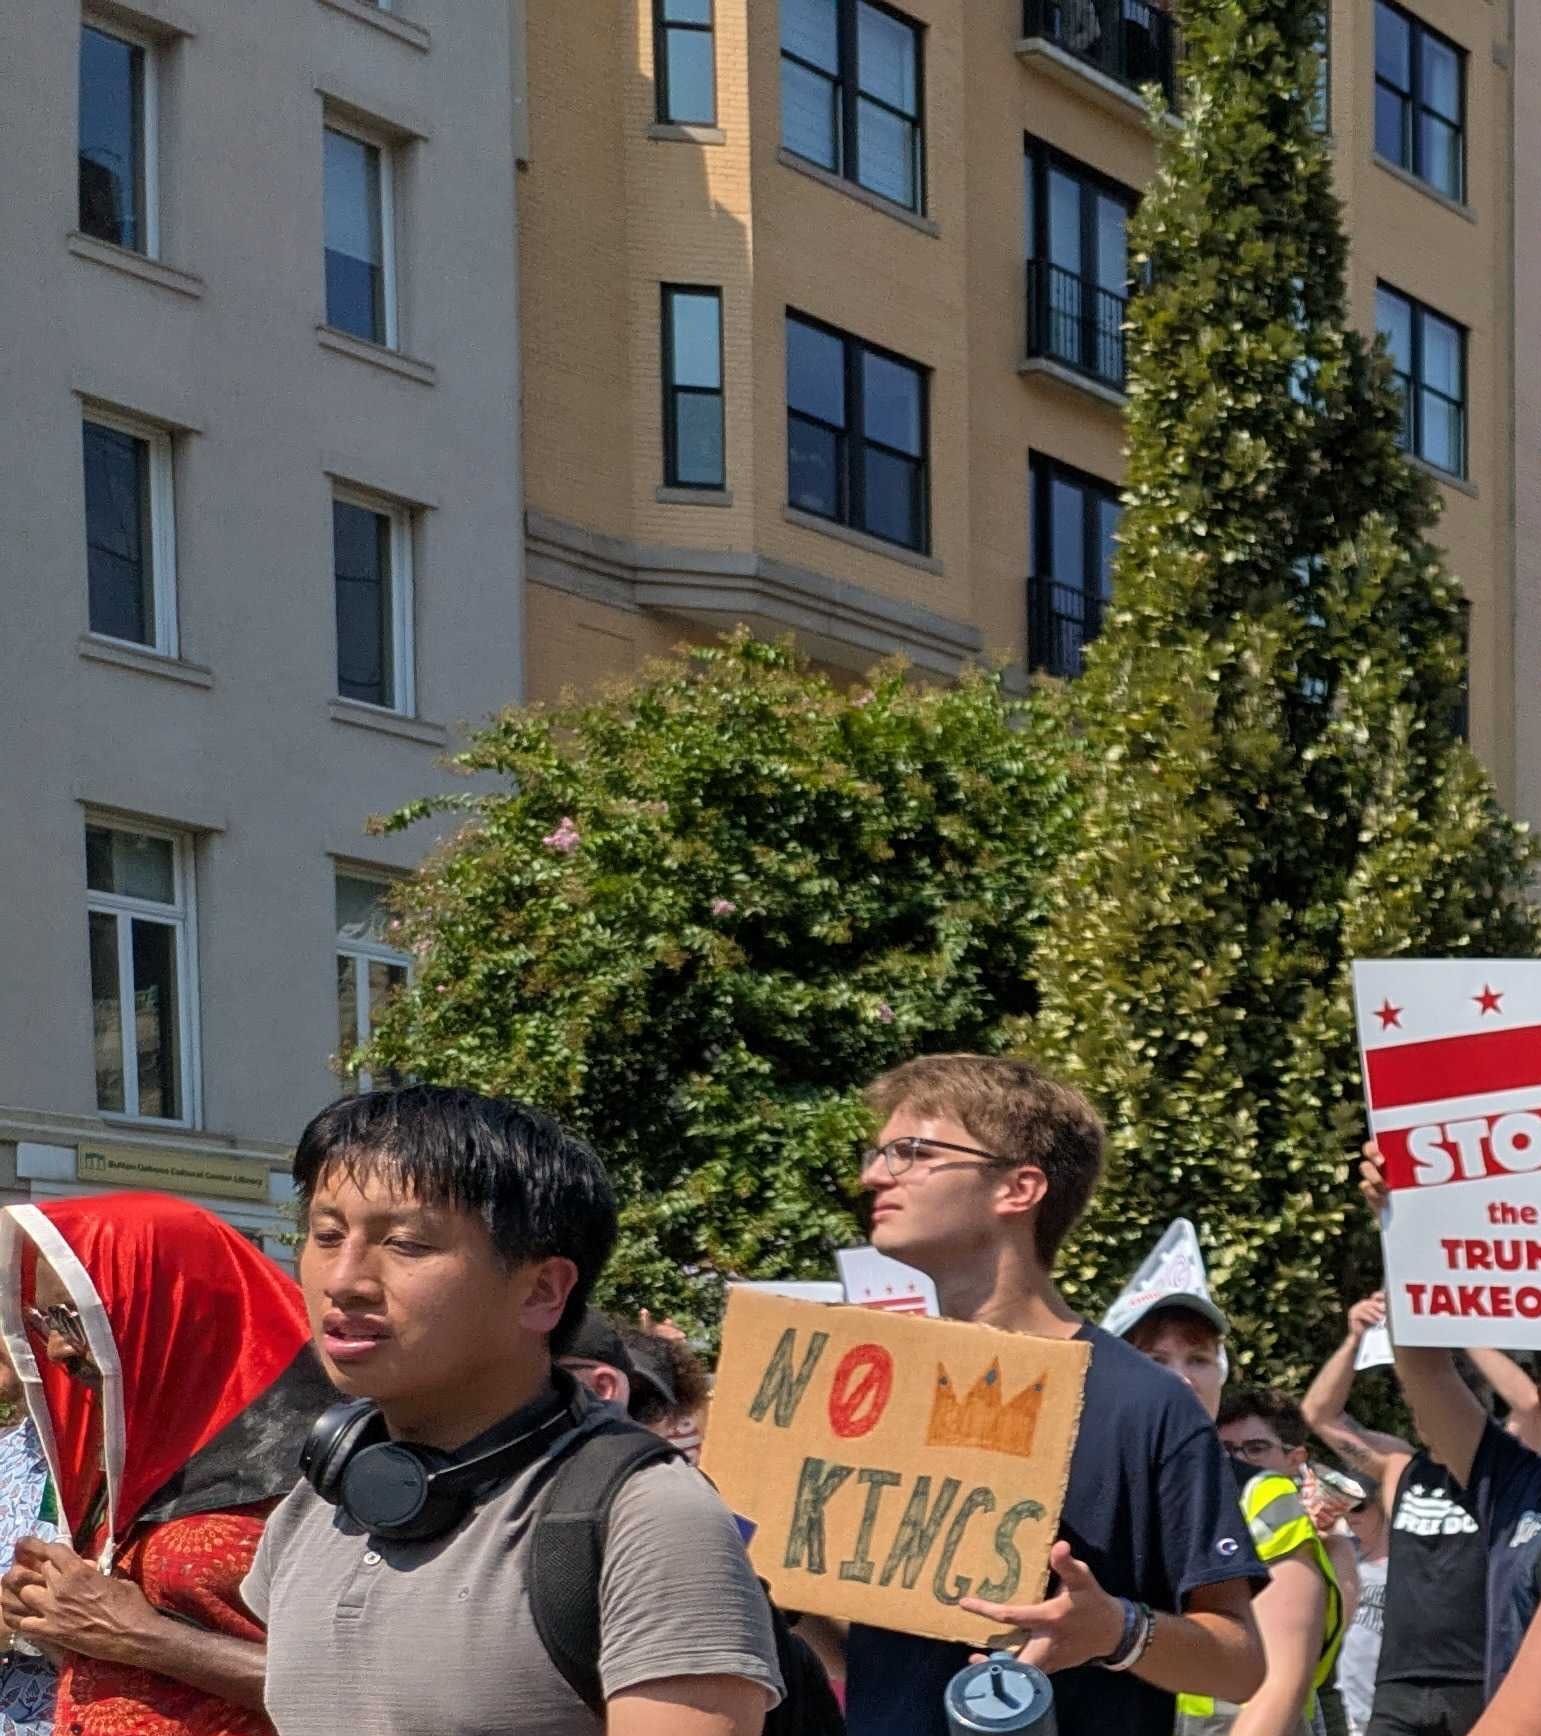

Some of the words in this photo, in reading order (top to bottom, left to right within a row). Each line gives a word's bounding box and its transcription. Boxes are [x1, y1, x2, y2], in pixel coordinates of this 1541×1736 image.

[1488, 1202, 1538, 1224] the
[749, 1328, 894, 1439] NO
[784, 1457, 1046, 1605] KINGS
[1393, 1511, 1441, 1536] FREE
